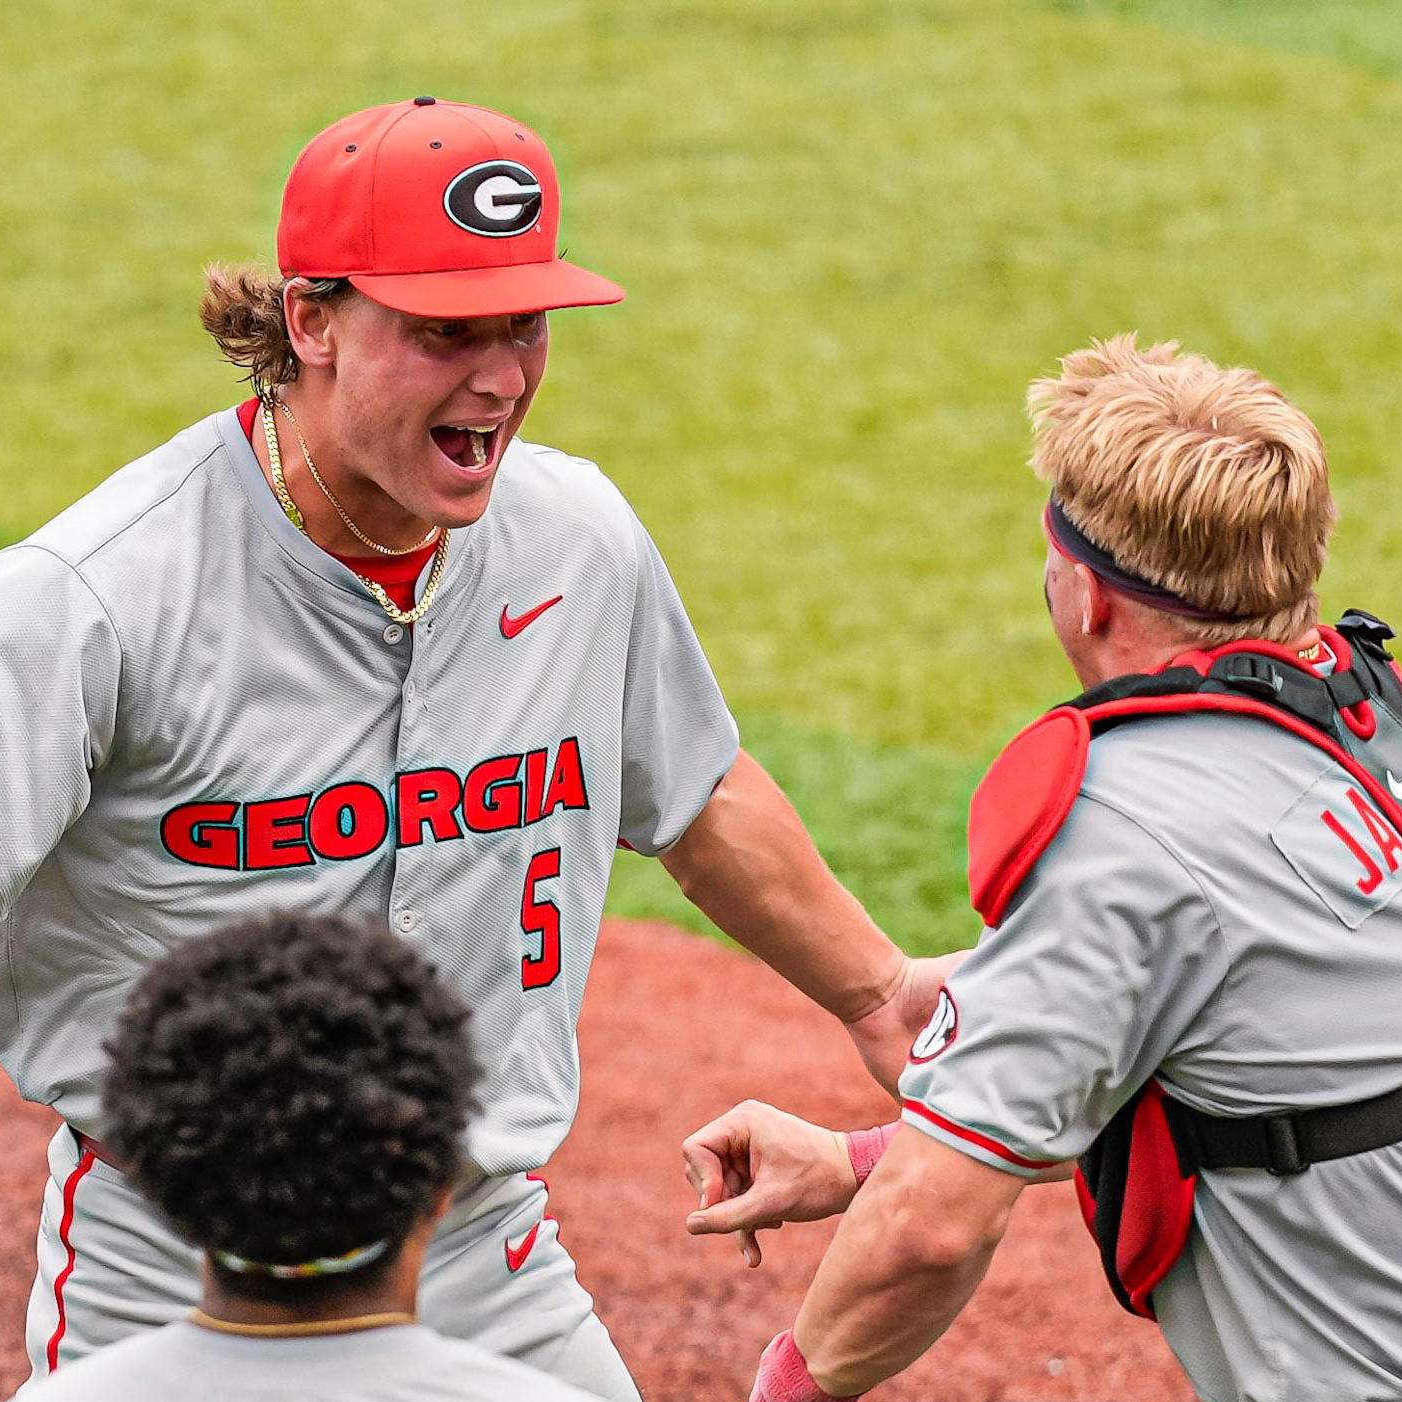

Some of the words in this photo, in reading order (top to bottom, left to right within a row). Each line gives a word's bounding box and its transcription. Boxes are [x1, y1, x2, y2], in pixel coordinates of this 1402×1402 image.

[443, 159, 542, 238] G
[160, 736, 590, 871] GEORGIA
[521, 847, 562, 991] 5
